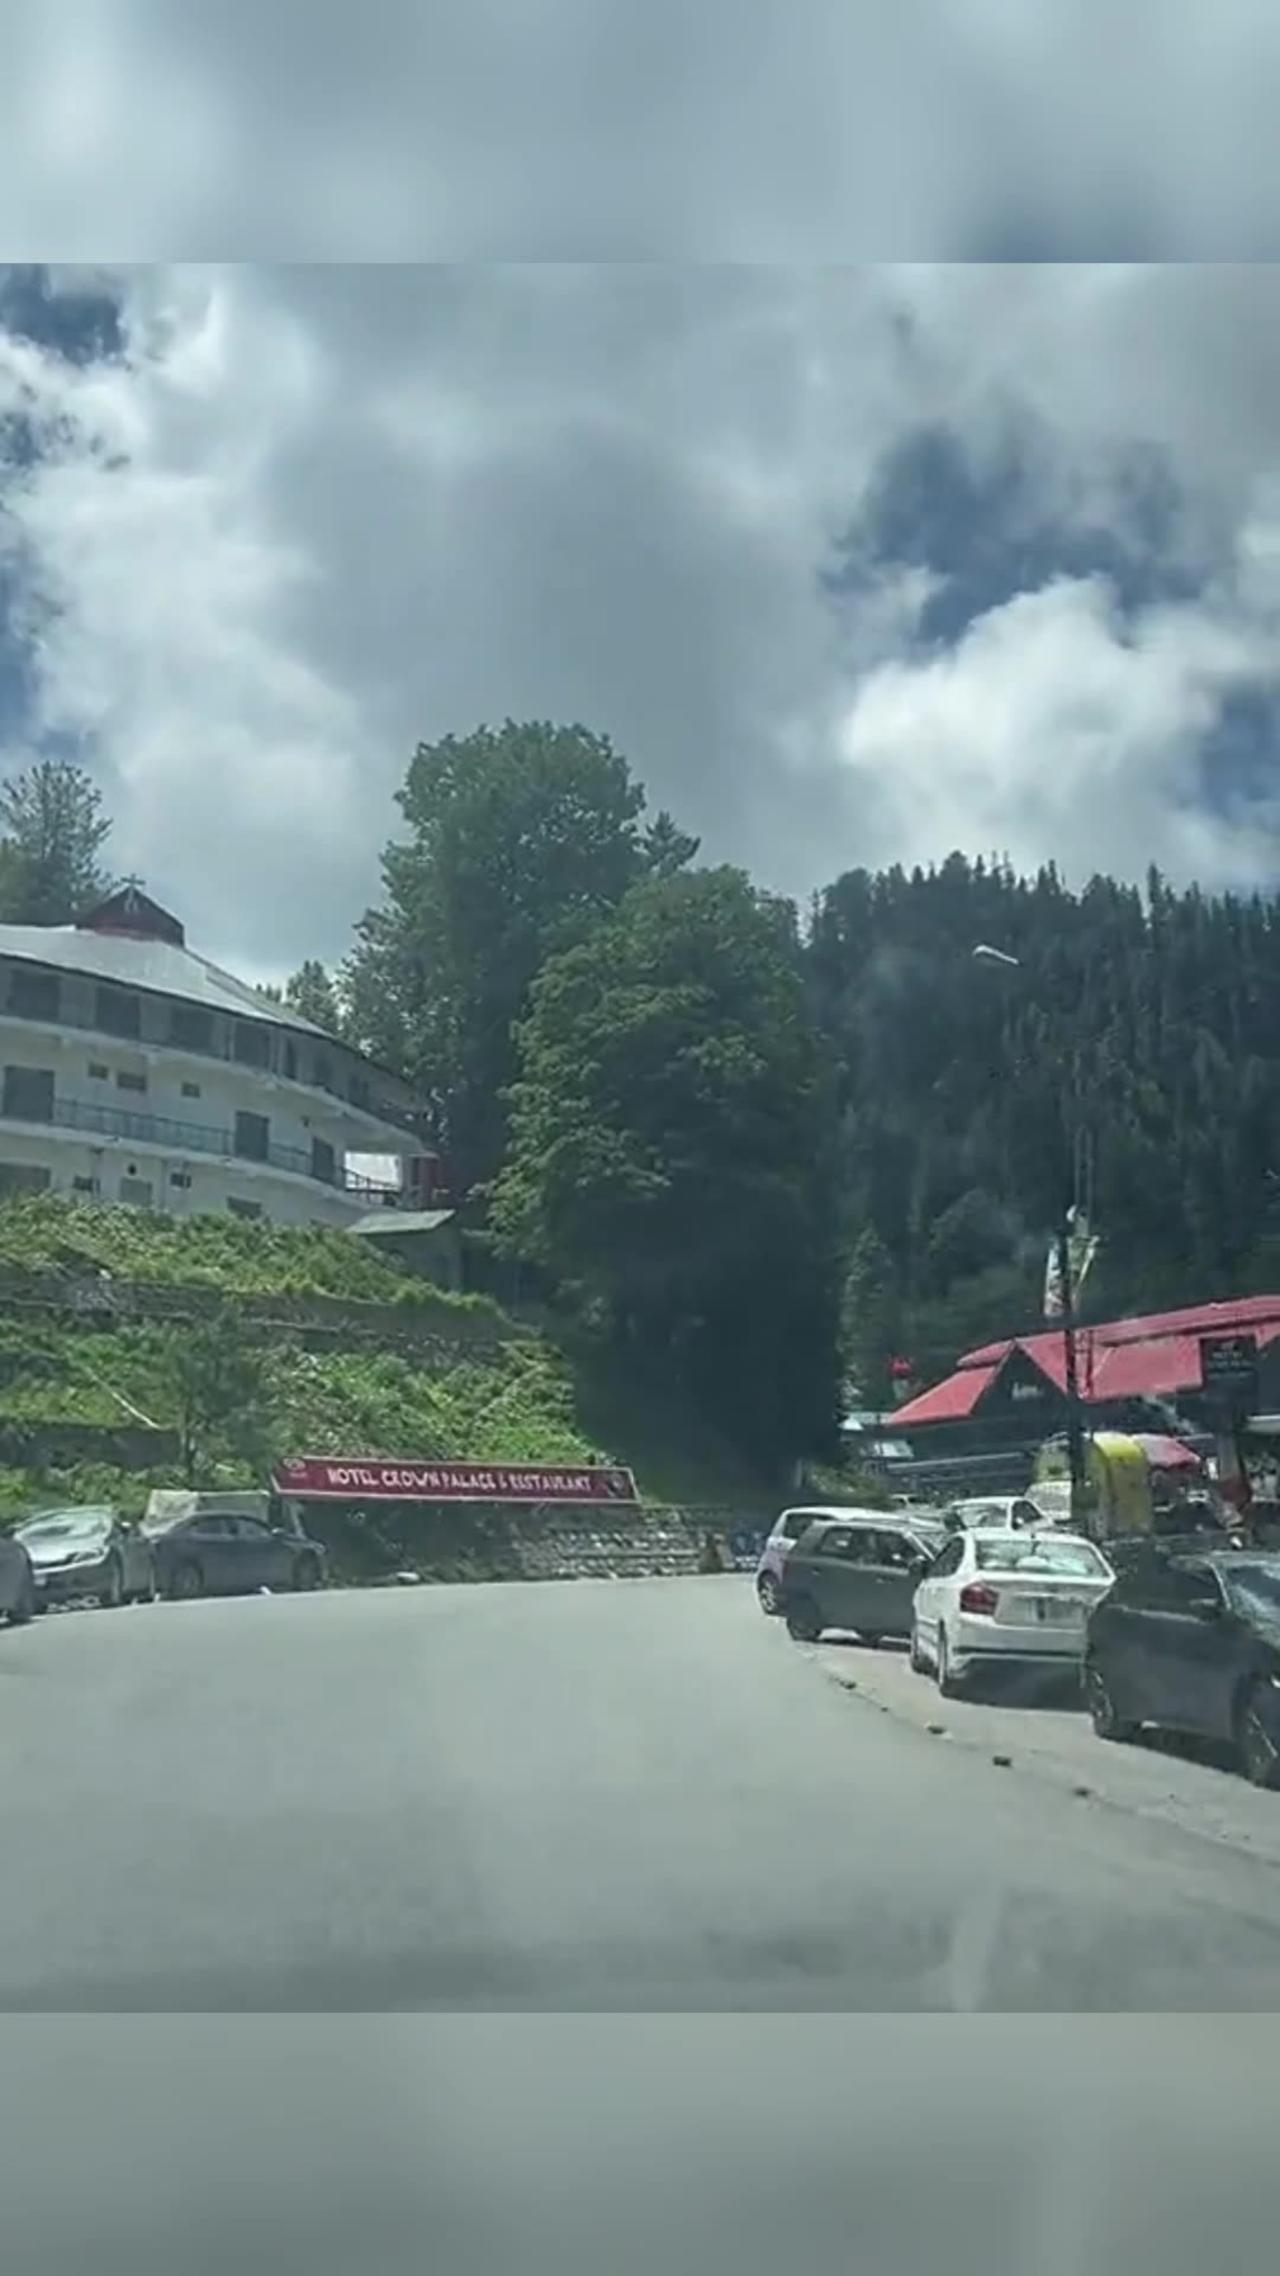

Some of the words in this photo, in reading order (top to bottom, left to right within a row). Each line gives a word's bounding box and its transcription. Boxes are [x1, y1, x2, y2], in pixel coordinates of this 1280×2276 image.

[327, 1468, 379, 1485] HOTEL
[381, 1470, 440, 1488] CROWN
[442, 1472, 496, 1488] PALACE
[508, 1473, 591, 1490] RESTAURANT
